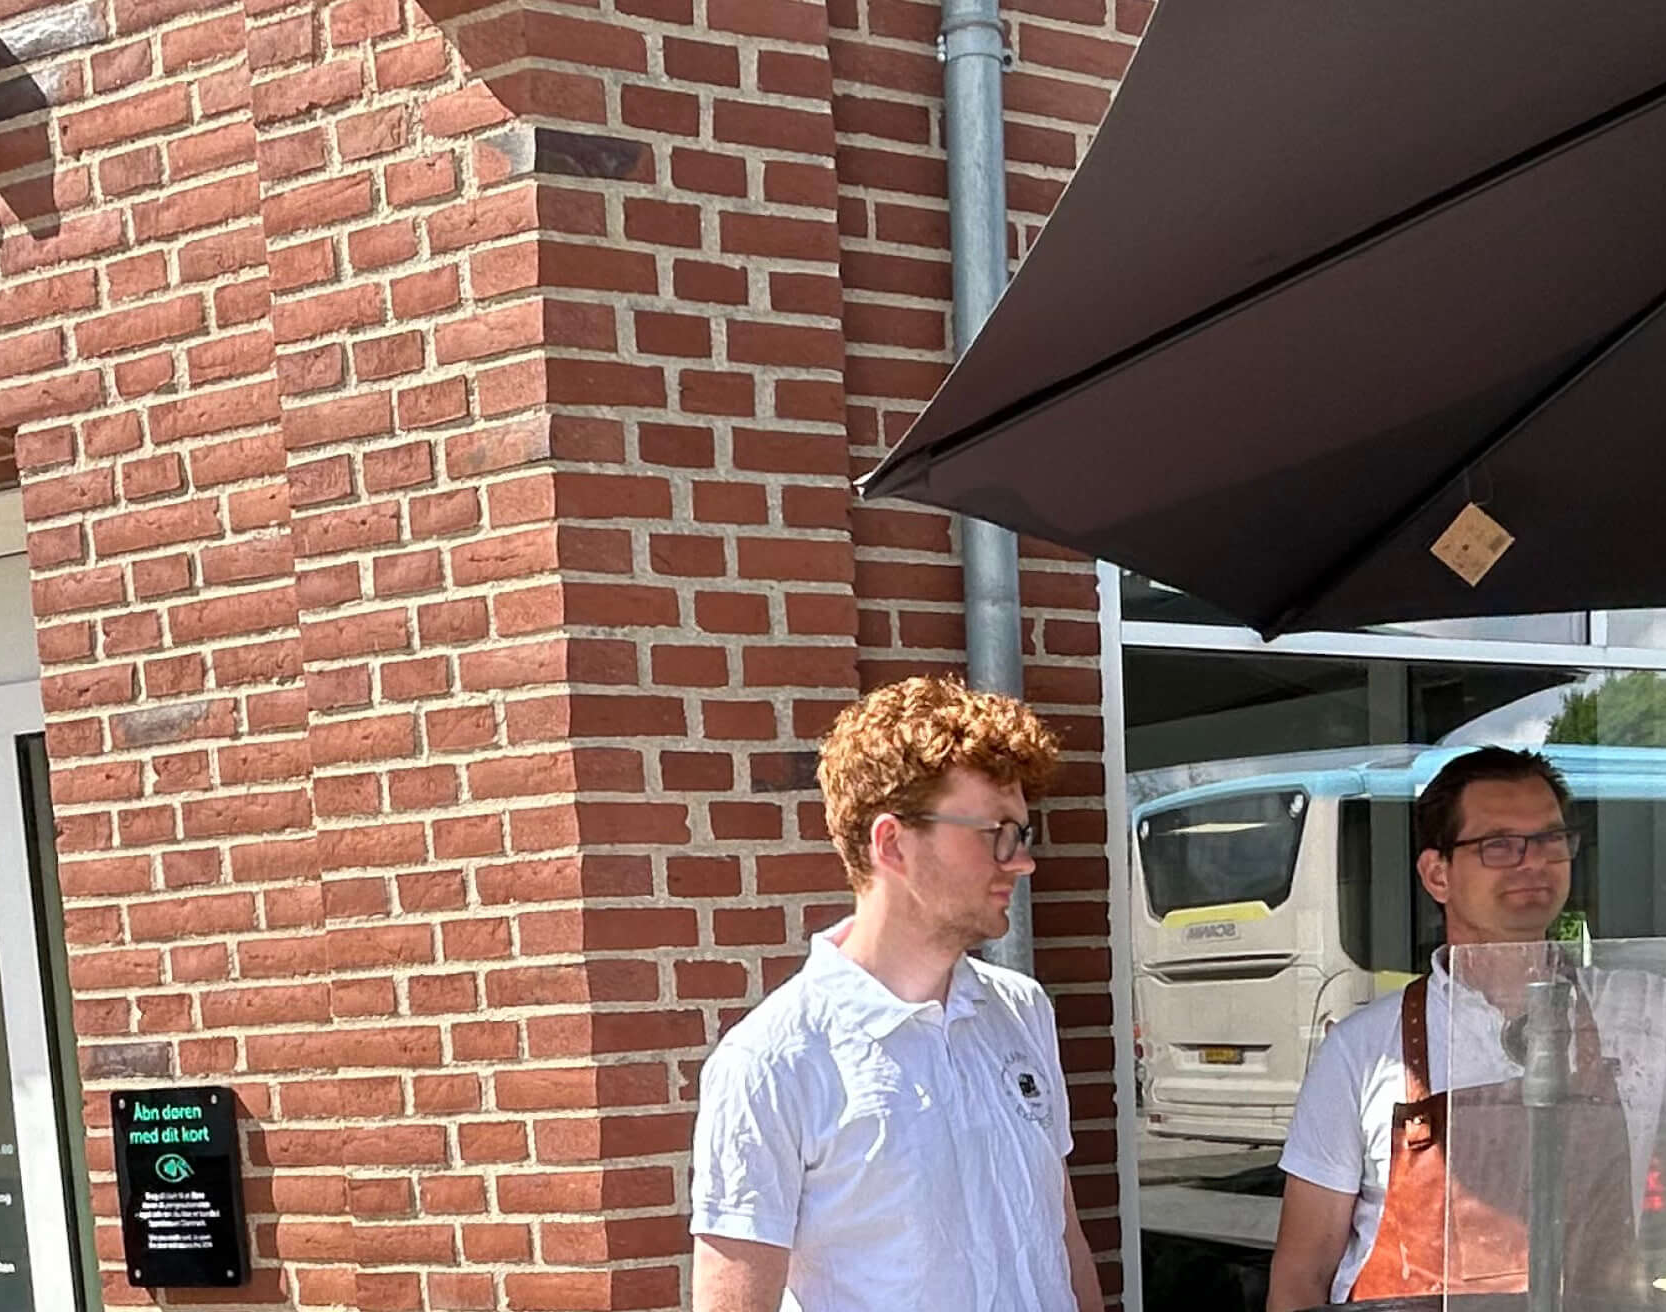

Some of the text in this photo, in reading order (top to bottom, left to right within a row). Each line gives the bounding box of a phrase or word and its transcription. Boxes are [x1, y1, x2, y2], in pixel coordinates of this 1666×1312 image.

[133, 1102, 160, 1121] Åbn
[129, 1126, 210, 1144] med dit kort
